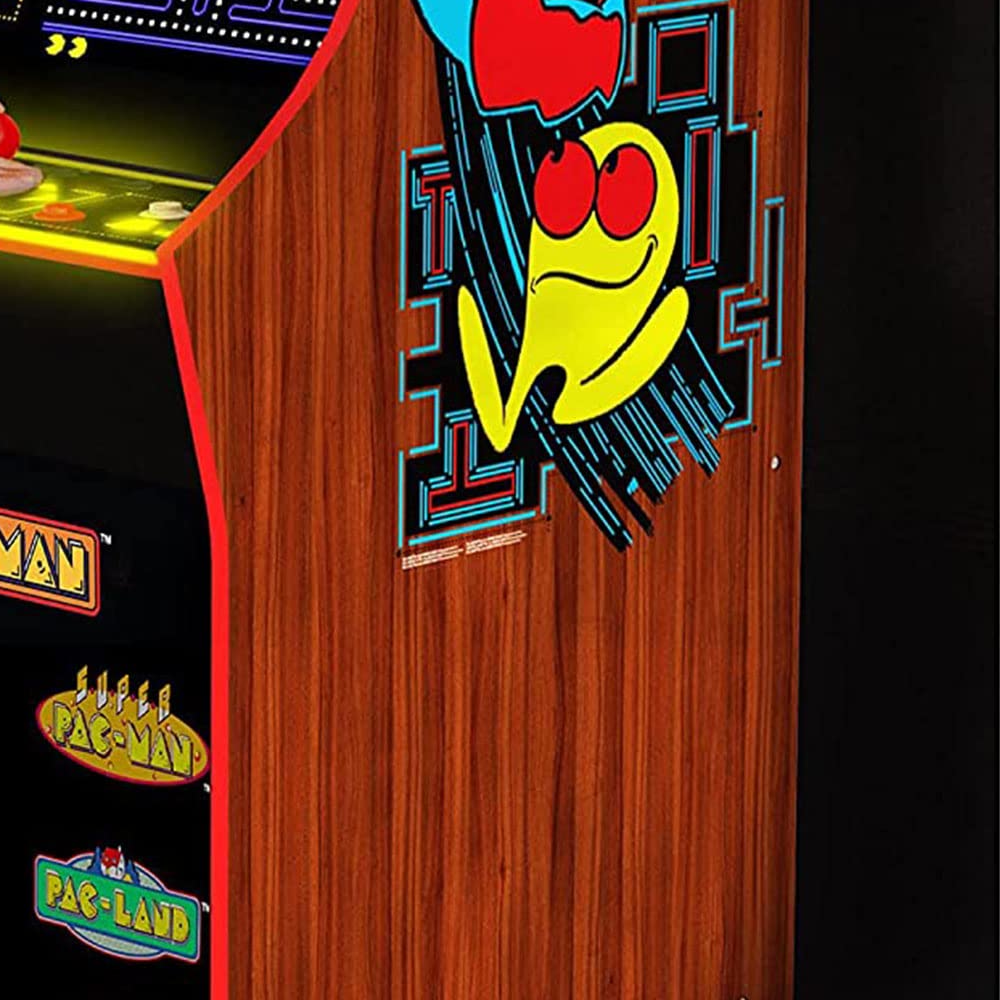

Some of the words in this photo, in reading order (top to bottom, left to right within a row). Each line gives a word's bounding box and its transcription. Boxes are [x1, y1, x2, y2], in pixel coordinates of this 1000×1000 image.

[76, 664, 171, 724] SUPER
[53, 700, 194, 779] PAC-MAN
[46, 868, 191, 945] PAC-LAND
